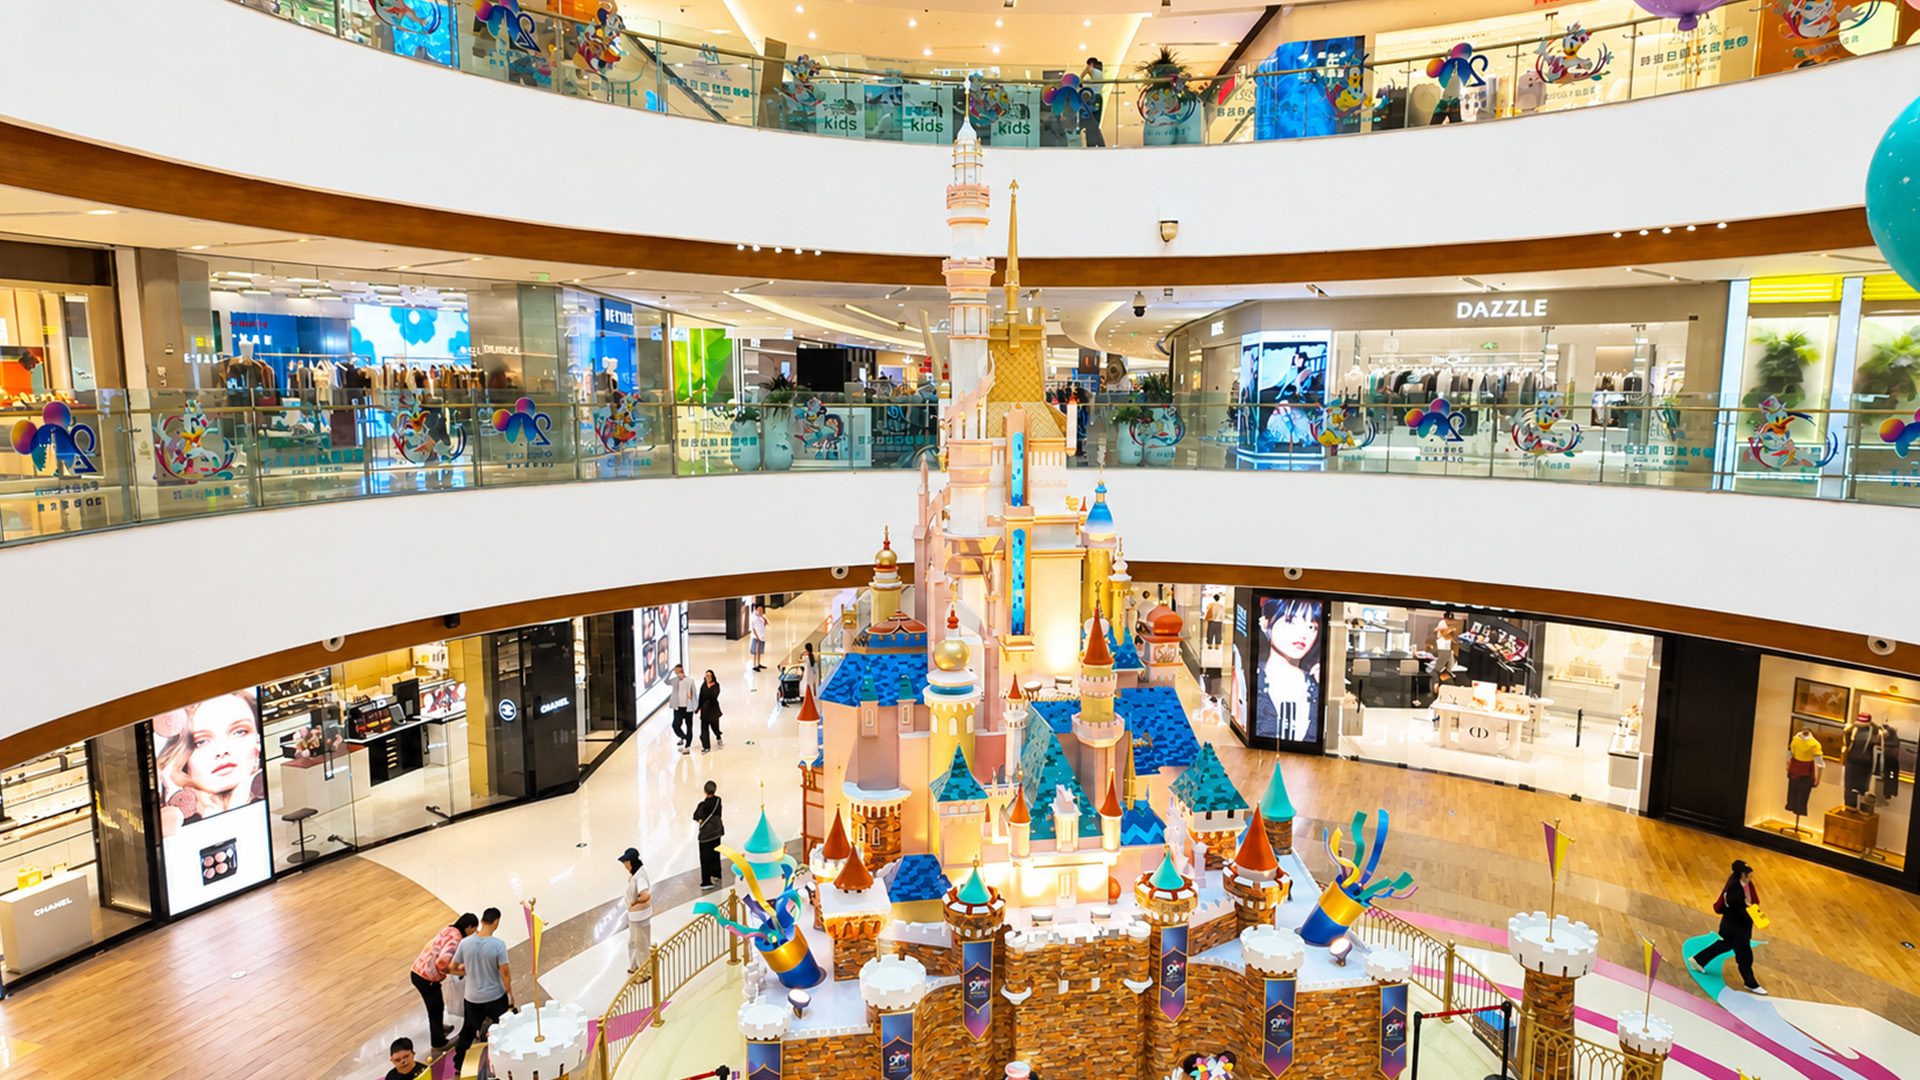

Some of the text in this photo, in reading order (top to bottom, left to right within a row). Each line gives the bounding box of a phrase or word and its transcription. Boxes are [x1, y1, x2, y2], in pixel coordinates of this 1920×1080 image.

[824, 115, 857, 131] kids
[911, 118, 944, 133] kids
[998, 121, 1031, 135] kids
[1456, 299, 1548, 319] DAZZLE
[33, 897, 73, 917] CHANEL
